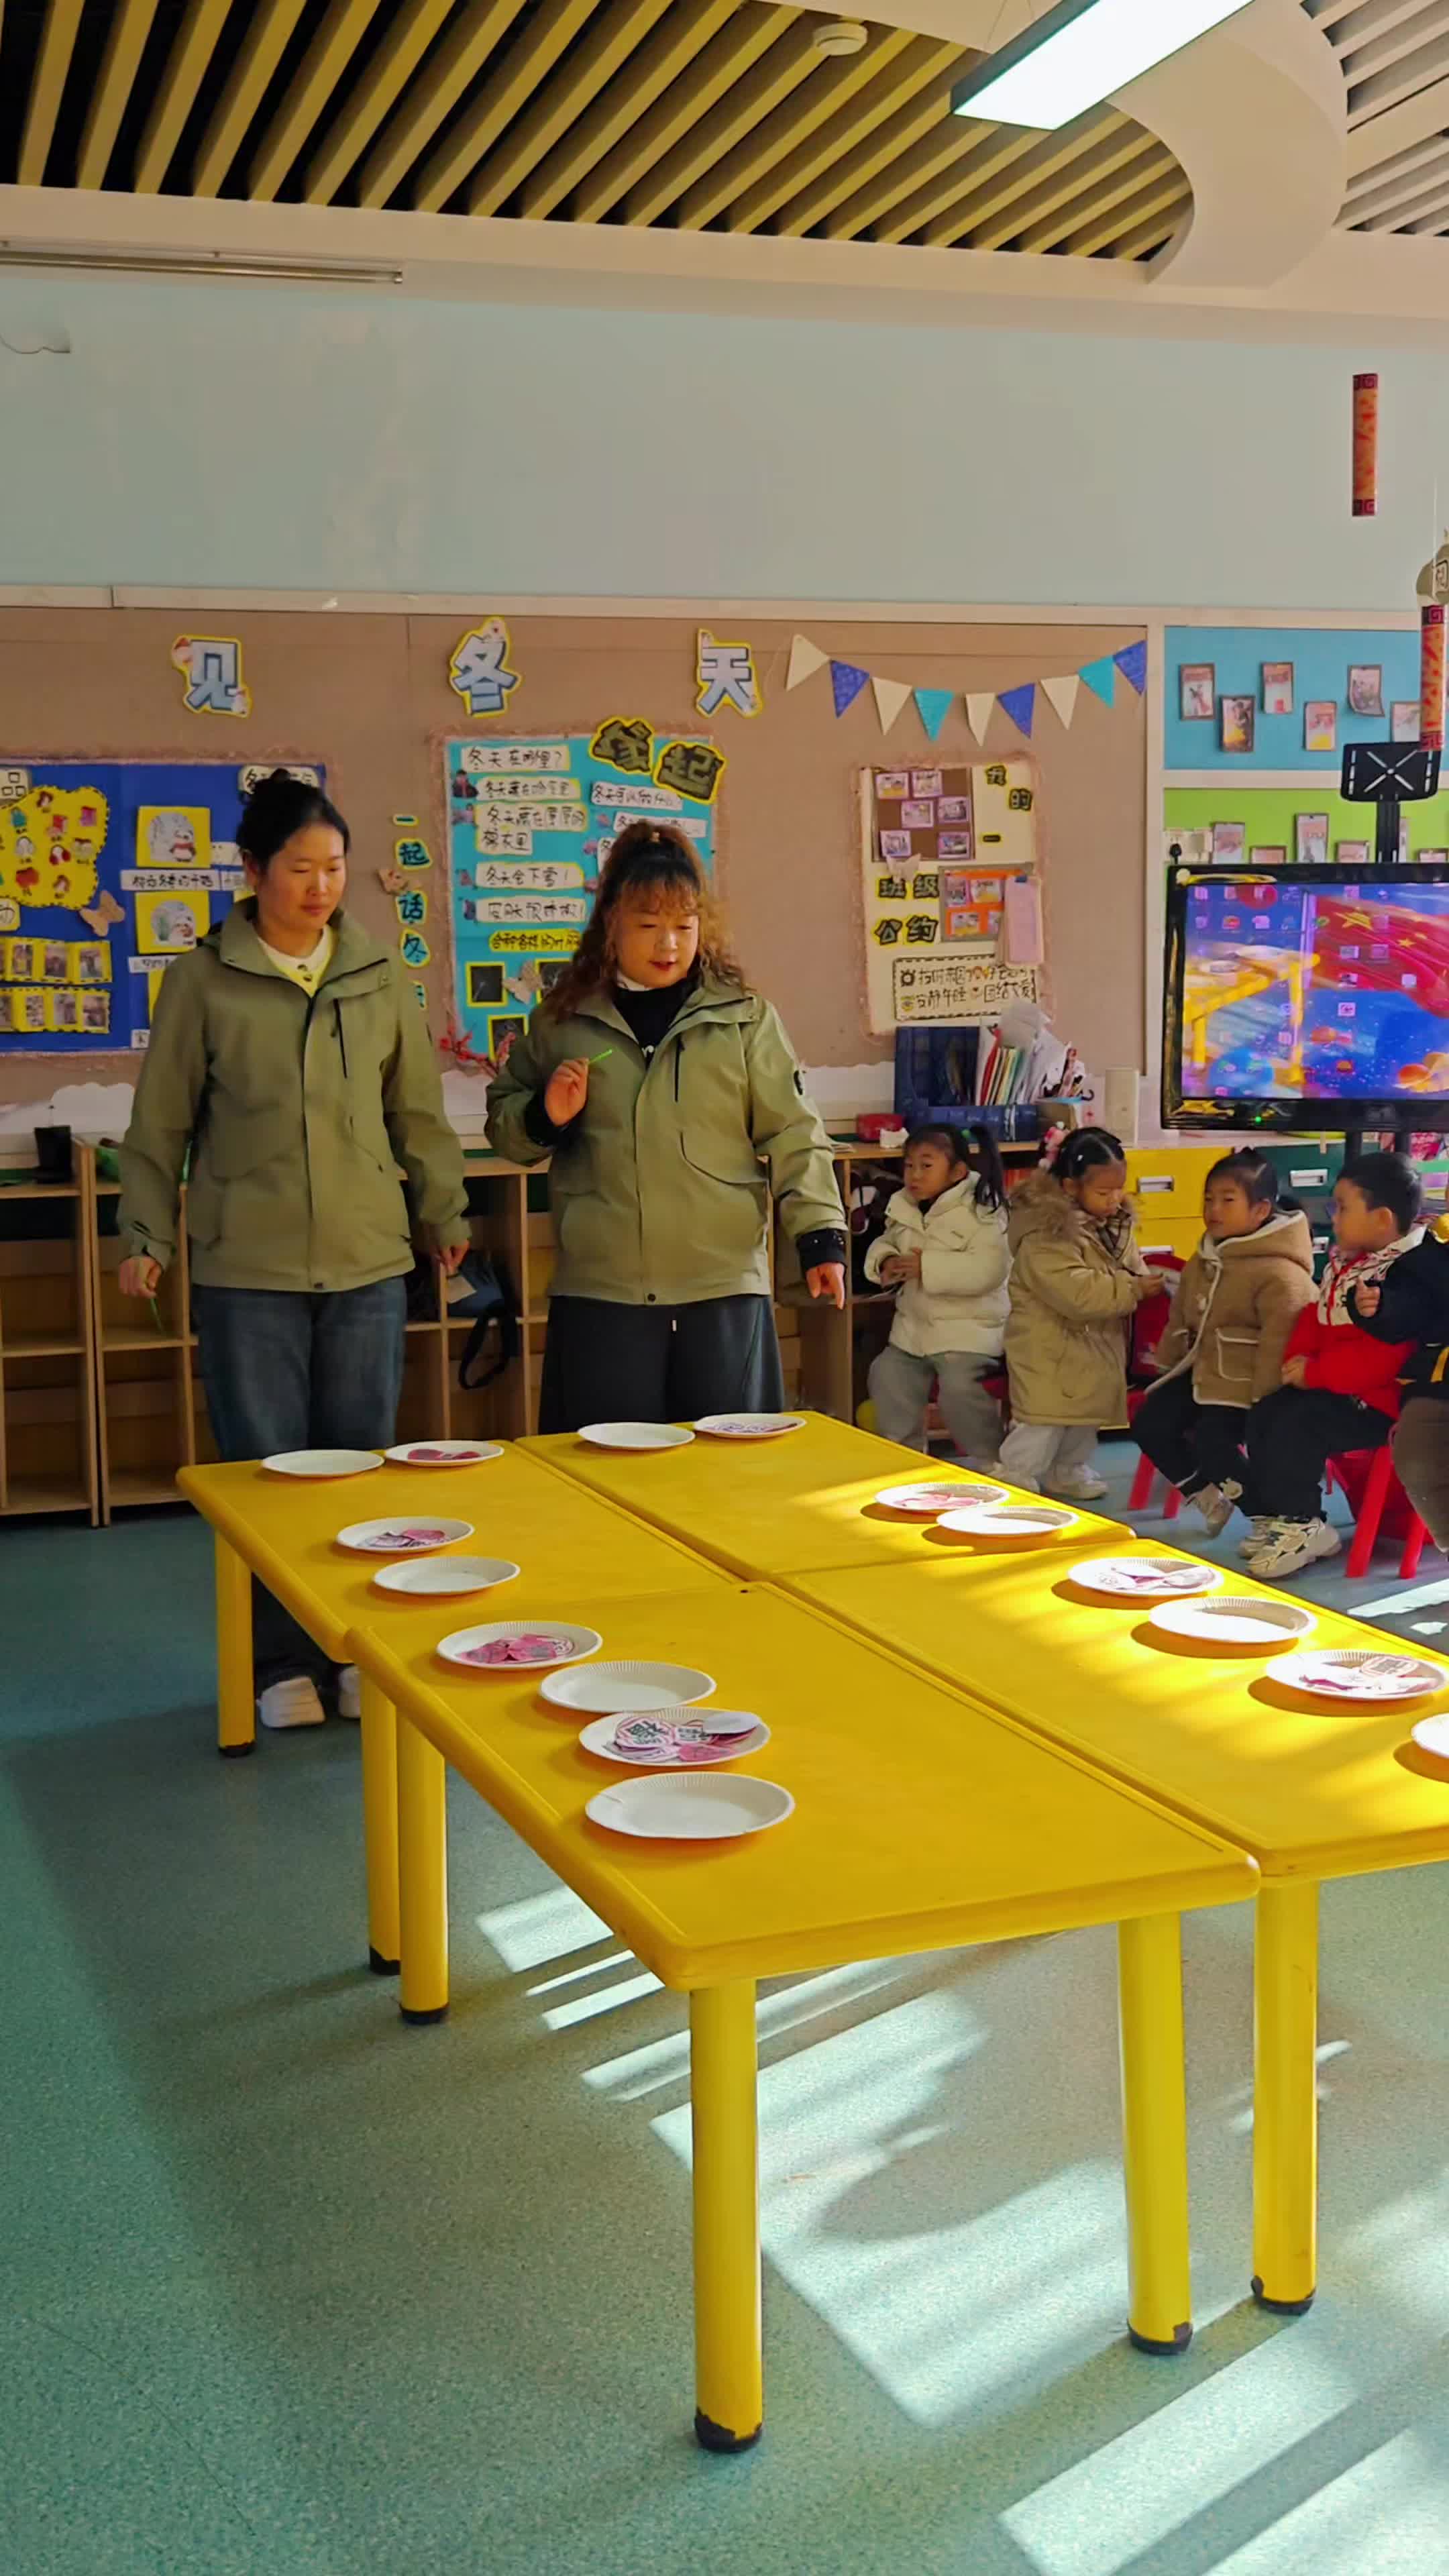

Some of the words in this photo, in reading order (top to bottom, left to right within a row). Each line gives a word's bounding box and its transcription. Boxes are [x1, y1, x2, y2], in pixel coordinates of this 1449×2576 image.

[184, 639, 240, 712] 见
[451, 633, 519, 715] 冬
[698, 645, 755, 716] 天
[878, 873, 939, 900] 班级
[874, 914, 938, 945] 公约
